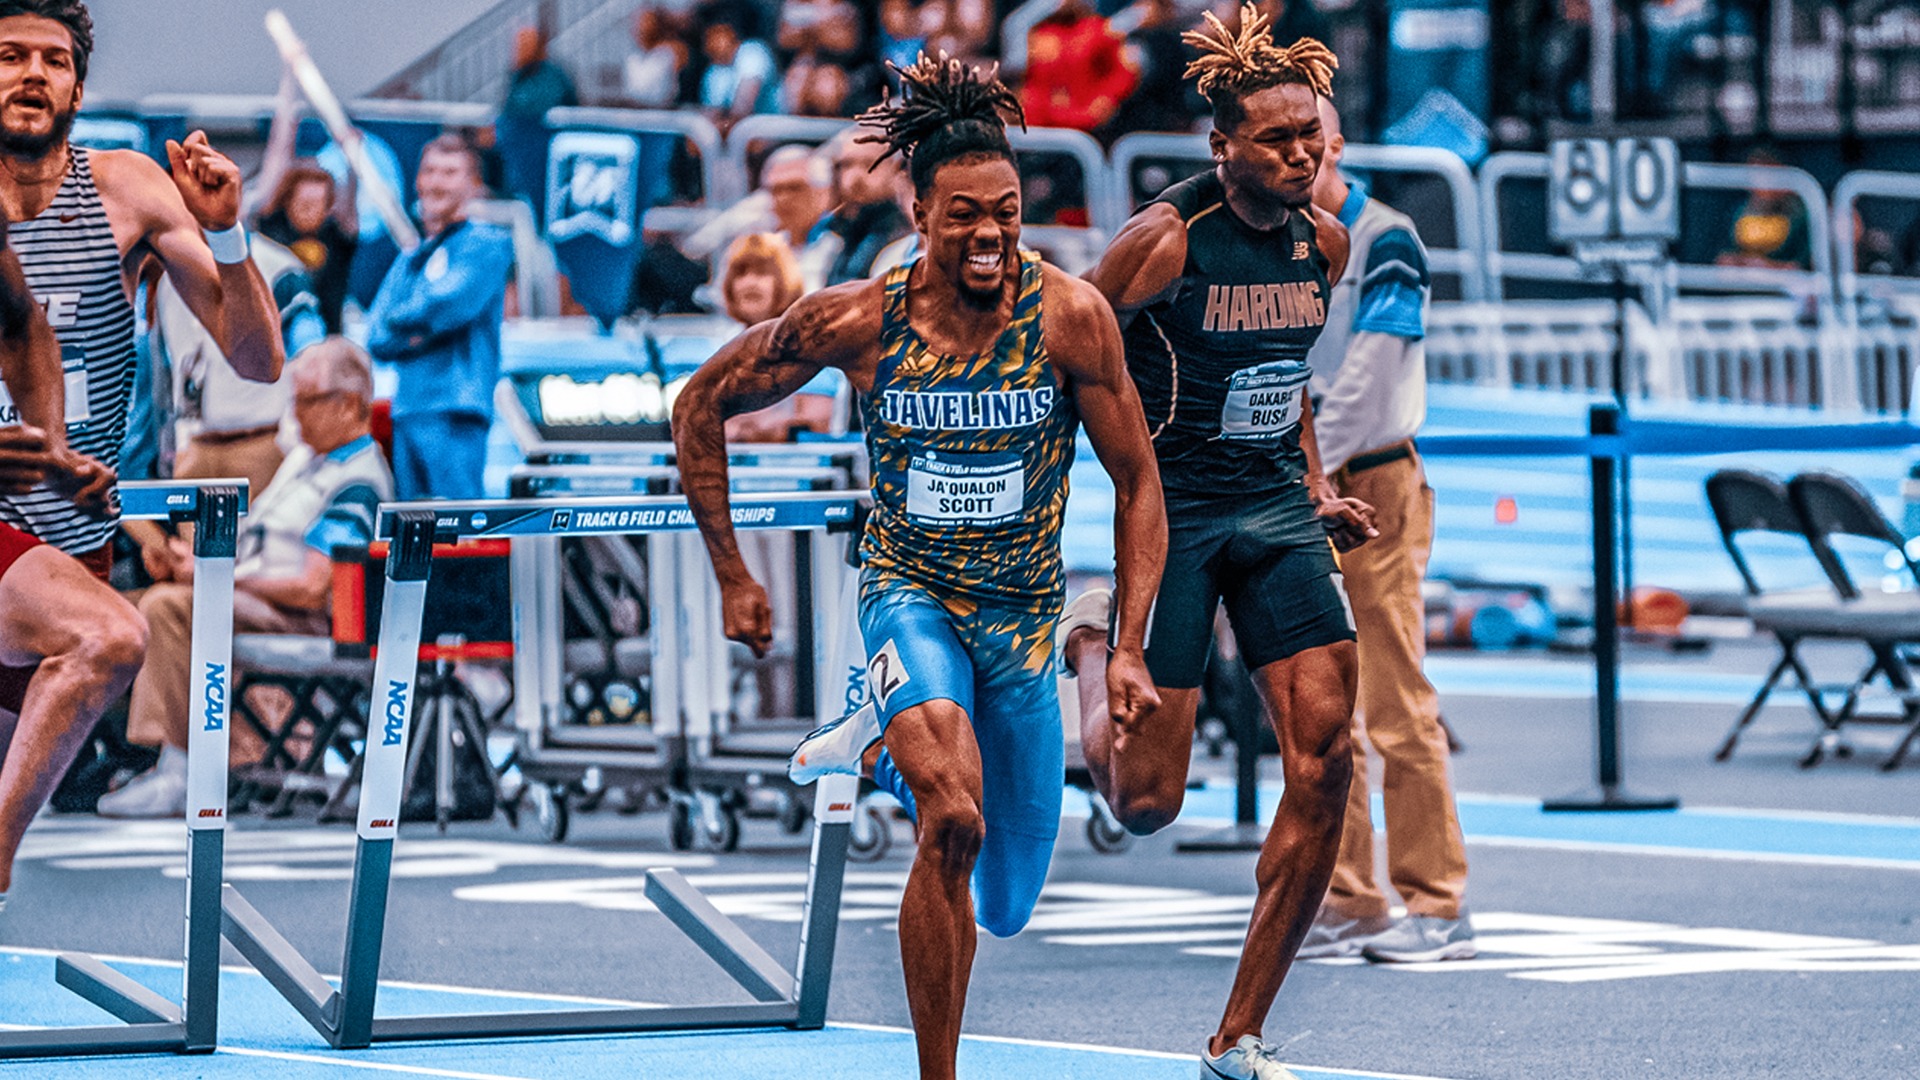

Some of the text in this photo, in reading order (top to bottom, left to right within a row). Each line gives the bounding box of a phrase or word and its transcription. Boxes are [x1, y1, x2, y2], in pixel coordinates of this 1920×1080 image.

[1564, 143, 1665, 214] 80
[1202, 280, 1326, 331] HARDING
[879, 386, 1053, 430] JAVELINAS
[1251, 407, 1289, 426] BUSH
[927, 479, 1006, 496] JA'QUALON
[939, 498, 995, 513] SCOTT
[436, 517, 459, 527] GILL
[576, 512, 619, 528] TRACK
[617, 512, 630, 527] &
[629, 510, 666, 526] FIELD
[871, 653, 900, 700] 2
[204, 662, 225, 731] NCAA
[382, 680, 408, 746] NCAA
[198, 808, 223, 818] GILL
[370, 819, 395, 828] GILL
